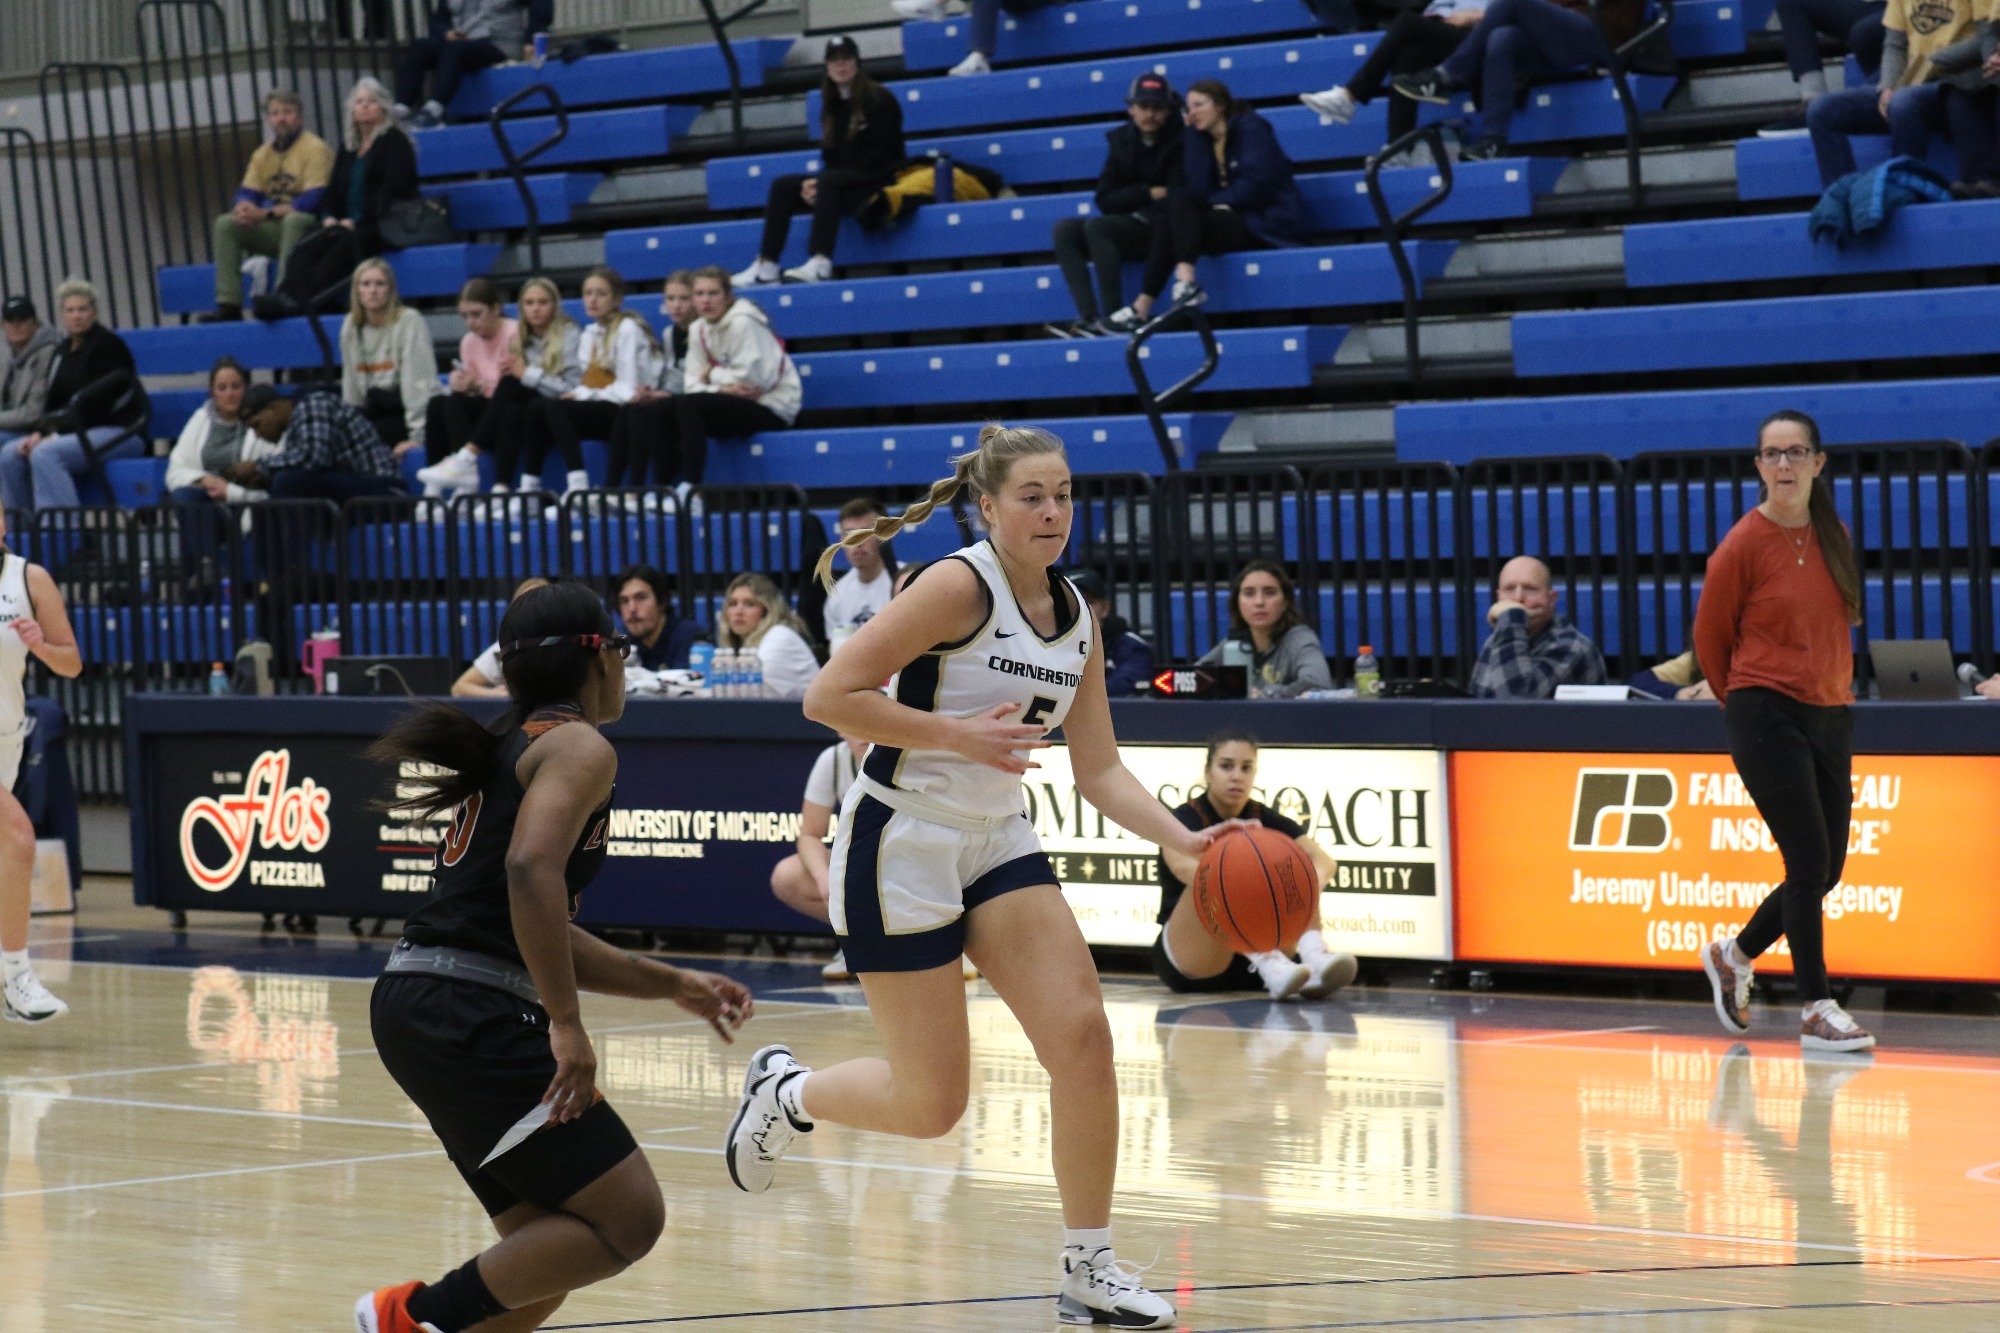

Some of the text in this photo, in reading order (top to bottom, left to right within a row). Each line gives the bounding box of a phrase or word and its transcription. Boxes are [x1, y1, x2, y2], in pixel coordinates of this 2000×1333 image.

[1850, 774, 1901, 810] EAU
[608, 808, 692, 840] NIVERSITY
[693, 810, 716, 840] OF
[717, 811, 804, 842] MICHIGAN
[250, 860, 326, 888] PIZZERIA
[1570, 868, 1903, 922] Jeremy Underwo gency
